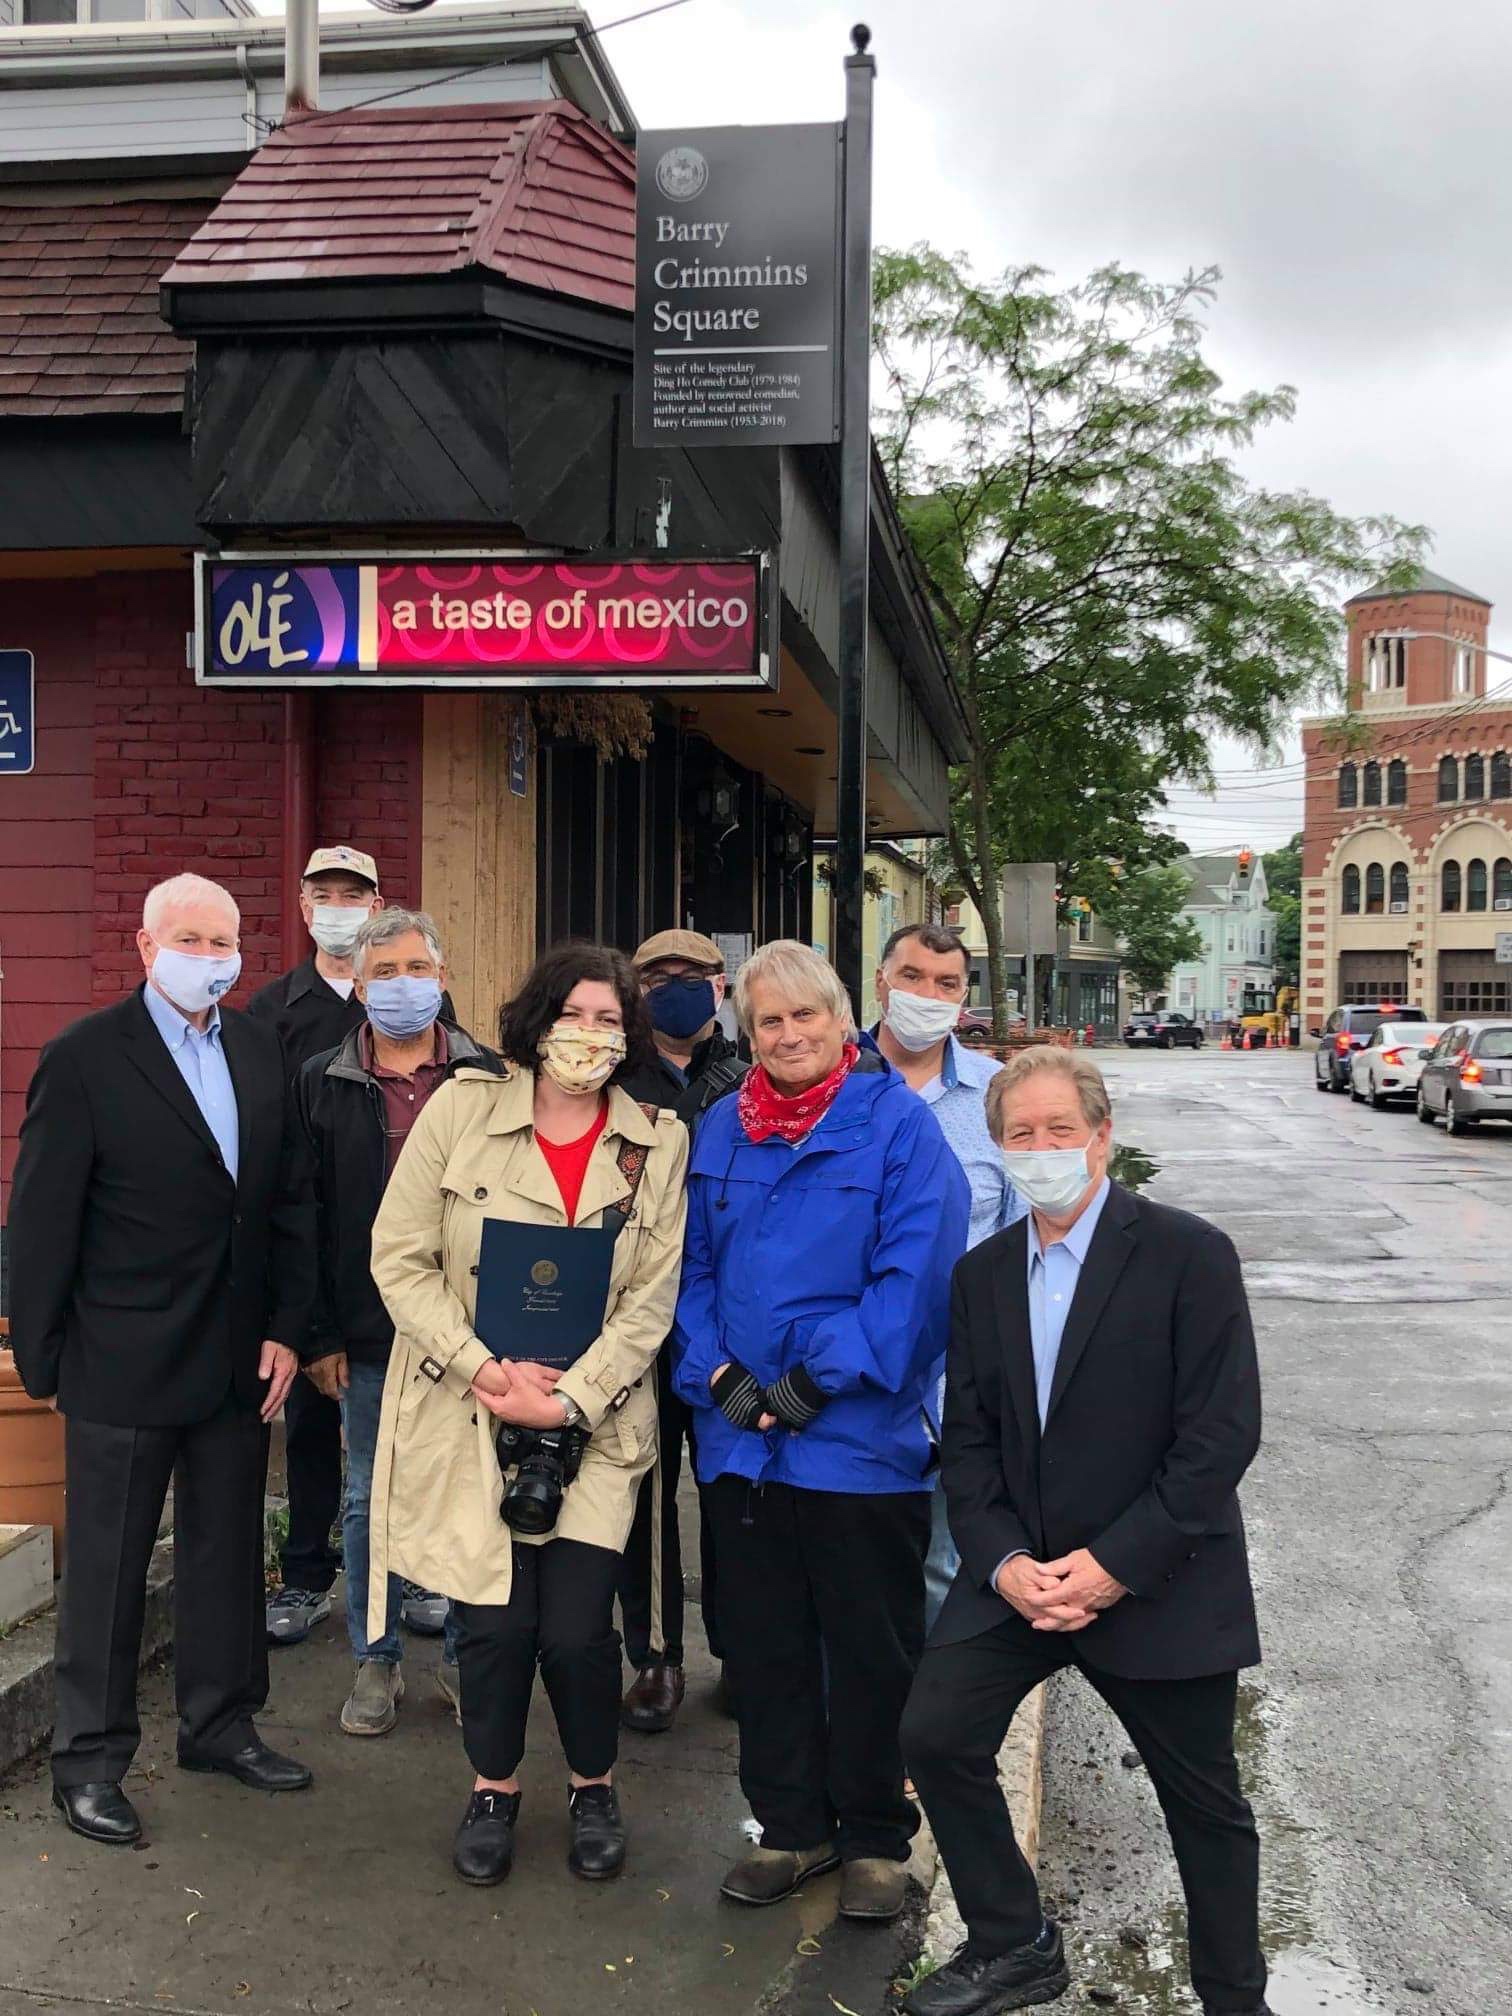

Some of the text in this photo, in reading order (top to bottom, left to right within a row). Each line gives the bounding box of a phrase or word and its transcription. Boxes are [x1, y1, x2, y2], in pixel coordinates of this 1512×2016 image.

[656, 215, 730, 248] Barry
[654, 256, 808, 289] Crimmins
[653, 301, 760, 341] Square
[653, 361, 755, 376] Site of the legendary
[654, 376, 675, 390] Ding
[692, 376, 726, 389] Comedy
[728, 375, 750, 386] Club
[653, 389, 692, 401] Founded
[694, 388, 704, 403] by
[708, 388, 752, 400] renowned
[653, 401, 771, 414] author and social activist
[653, 417, 679, 431] Barry
[681, 416, 728, 428] Crimmins
[392, 589, 748, 630] a taste of mexico
